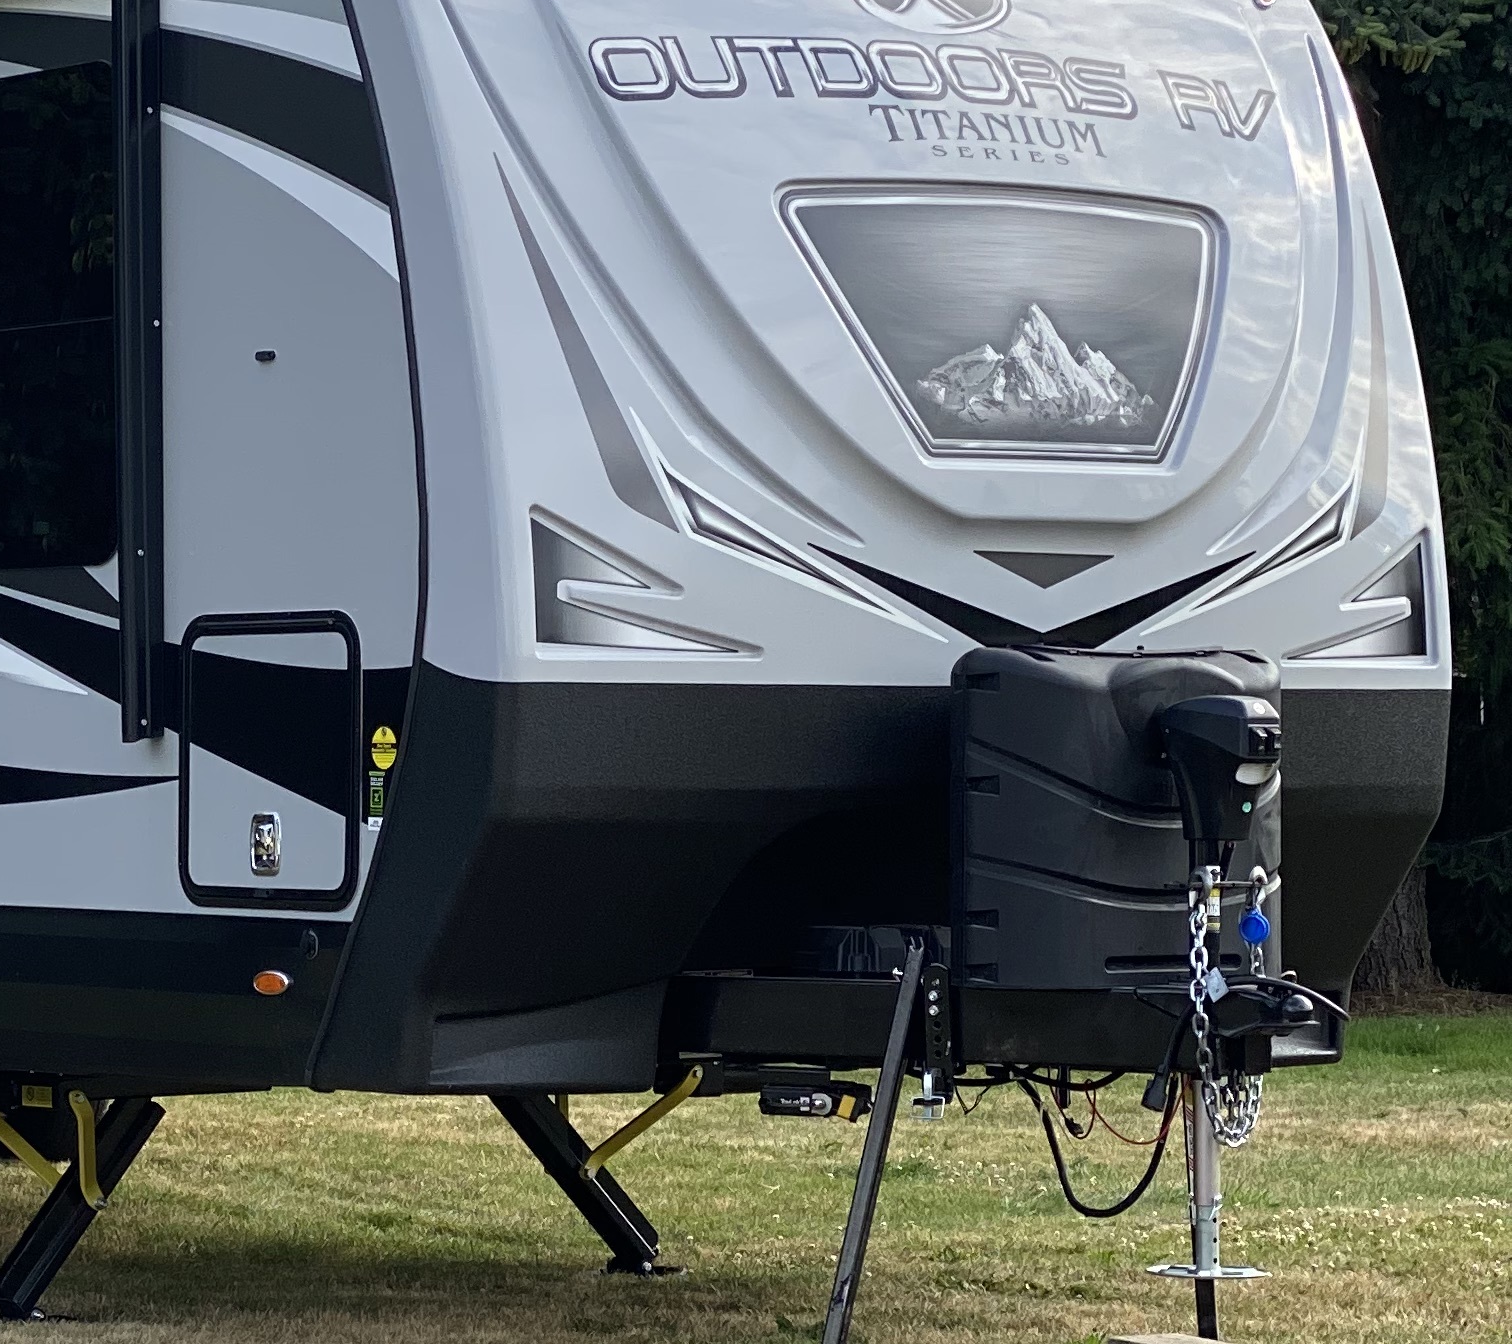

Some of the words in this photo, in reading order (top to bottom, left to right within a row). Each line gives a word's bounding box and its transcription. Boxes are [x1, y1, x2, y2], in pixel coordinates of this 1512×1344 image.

[588, 35, 1138, 120] OUTDOORS
[1157, 69, 1278, 143] RV
[868, 103, 1107, 159] TITANIUM
[930, 144, 1071, 166] SERIES
